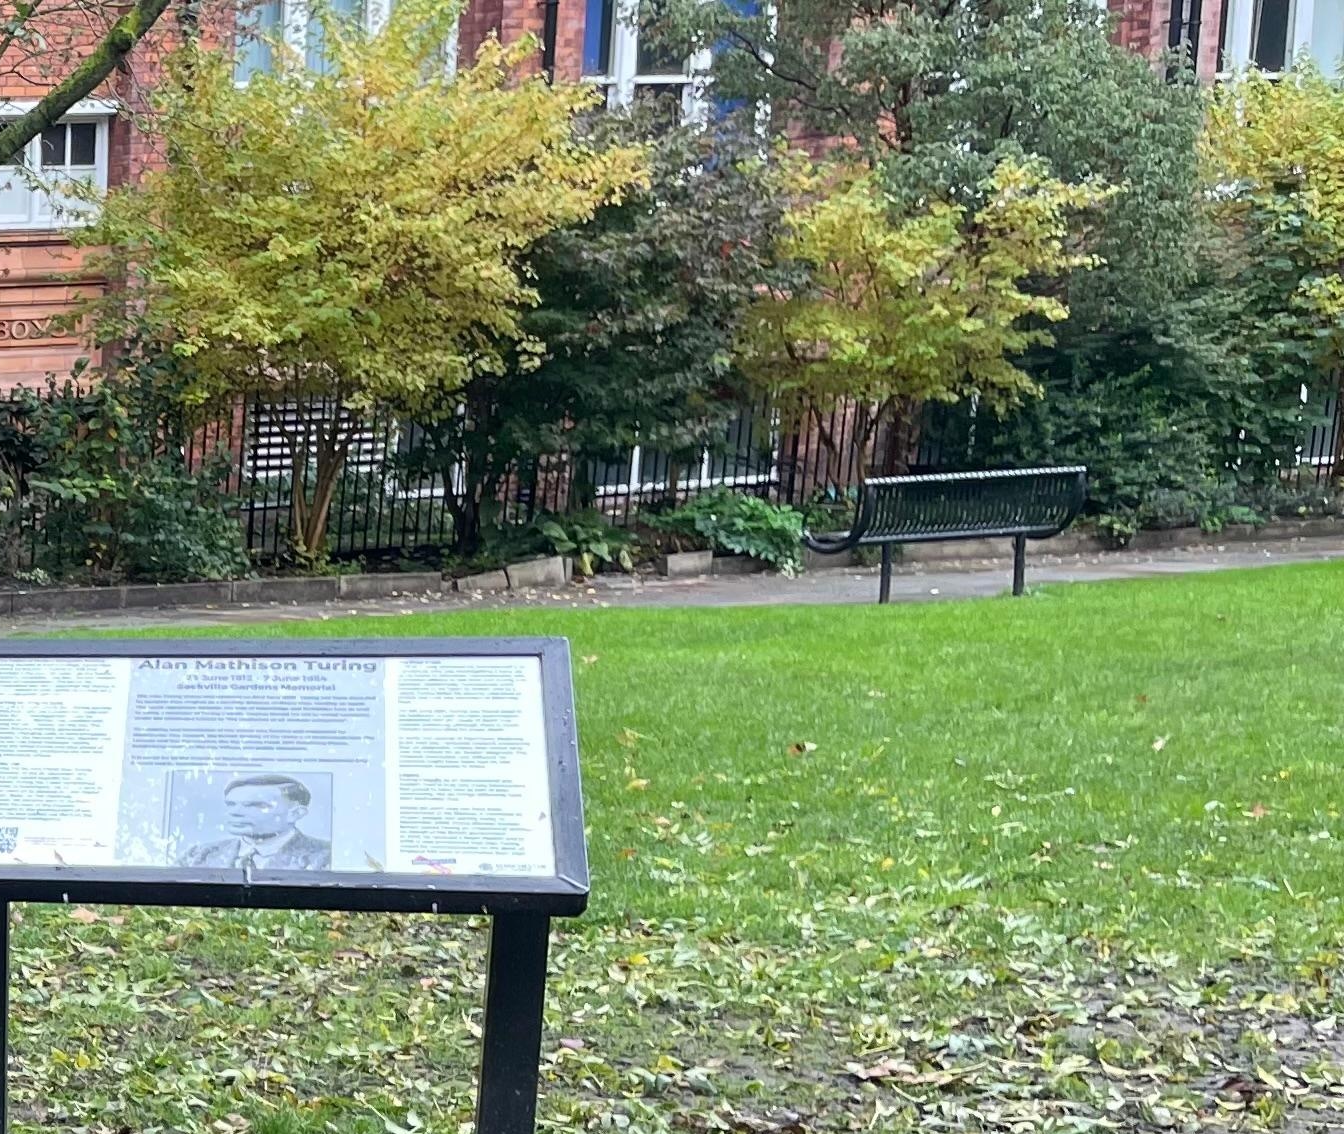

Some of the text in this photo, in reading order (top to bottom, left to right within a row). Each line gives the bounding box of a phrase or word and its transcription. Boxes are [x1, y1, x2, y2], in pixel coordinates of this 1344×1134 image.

[138, 659, 378, 673] Alan Mathison Turing
